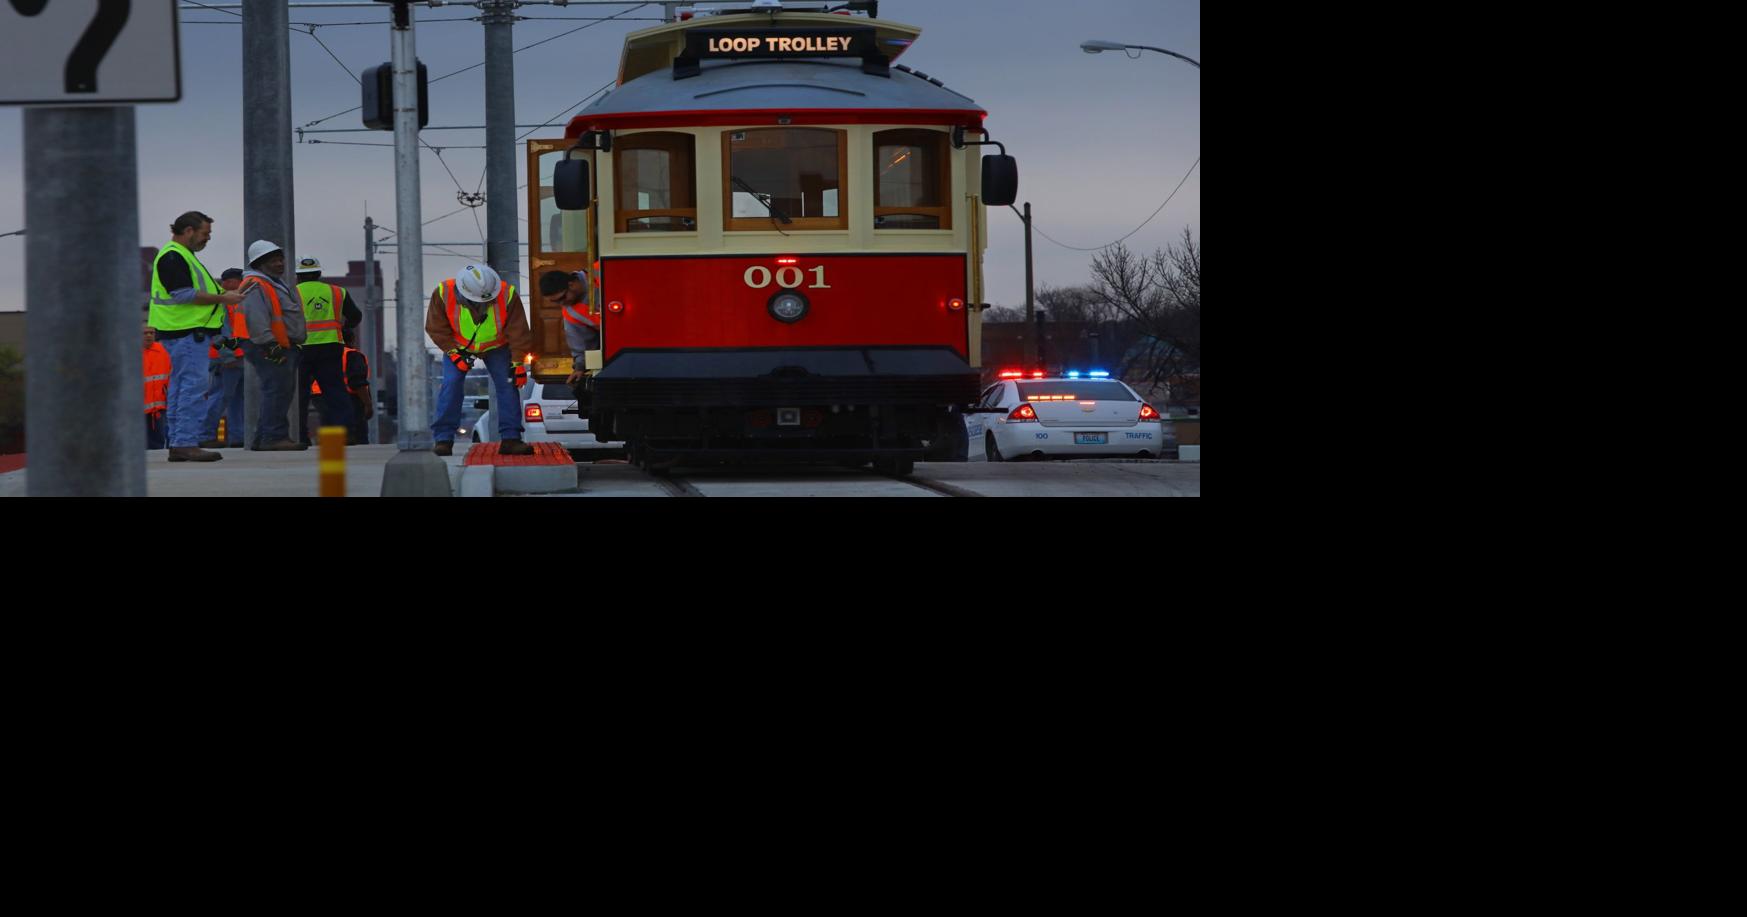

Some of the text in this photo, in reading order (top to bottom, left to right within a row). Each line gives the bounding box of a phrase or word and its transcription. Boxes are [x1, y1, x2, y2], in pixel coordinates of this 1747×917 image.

[709, 37, 852, 52] LOOP TROLLEY
[743, 265, 831, 289] 001
[1125, 432, 1153, 440] TRAFFIC
